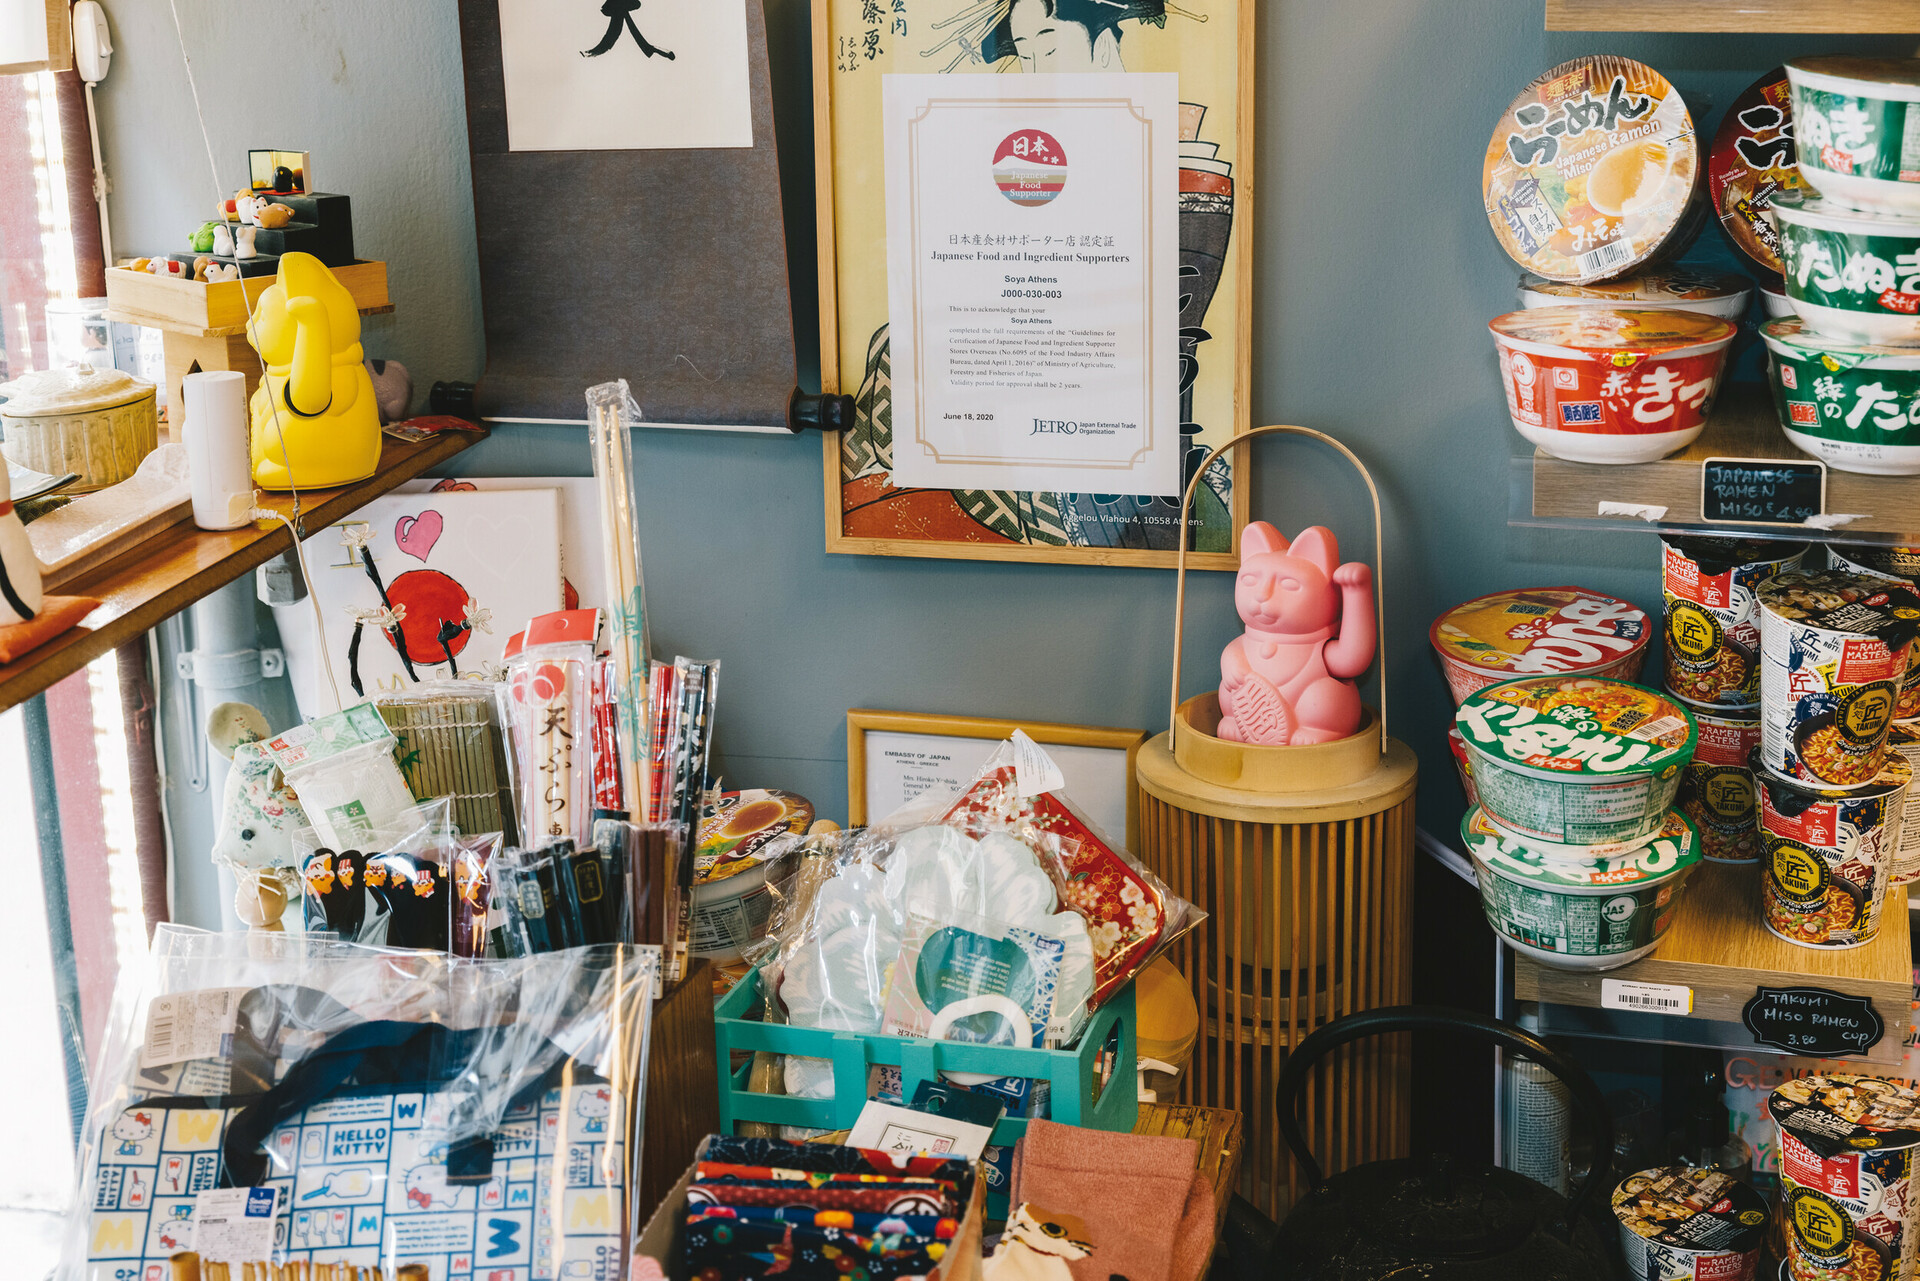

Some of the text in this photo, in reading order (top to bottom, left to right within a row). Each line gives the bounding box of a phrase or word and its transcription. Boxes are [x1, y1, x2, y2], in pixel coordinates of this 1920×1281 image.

[1507, 75, 1651, 168] らーめん
[1012, 135, 1050, 157] 日本
[1556, 119, 1662, 169] Japanese Ramen
[1010, 171, 1049, 180] Japanese
[1719, 170, 1734, 180] Ready
[1019, 180, 1041, 189] Food
[1721, 180, 1728, 188] 3
[1009, 188, 1052, 198] Supporter
[1515, 186, 1534, 204] Ramen
[1748, 181, 1778, 206] Authentic
[948, 234, 1115, 248] 日本産食材サポーター店 認定証
[1567, 217, 1626, 252] みそ味
[930, 251, 1129, 264] Japanese Food and Ingredient Supporters
[1004, 275, 1057, 284] Soya Athens
[1001, 289, 1062, 298] J000-030-003
[1067, 350, 1092, 358] Industry
[1600, 370, 1632, 413] 赤い
[1812, 376, 1847, 419] 緑の
[1029, 418, 1077, 435] JETRO
[1078, 428, 1116, 436] Organization
[1096, 422, 1120, 430] External
[1710, 465, 1795, 485] JAPANESE
[1713, 484, 1776, 499] RAMEN
[1720, 501, 1762, 517] MISO
[1063, 514, 1204, 527] Aggelou Vlahou 4, 10558 Atens
[1672, 555, 1699, 573] RAMEN
[1846, 649, 1892, 660] MASTERS
[1706, 726, 1741, 738] RAMEN
[1807, 806, 1829, 815] NISSIN
[1779, 875, 1812, 892] -TAKUMI-
[1603, 905, 1625, 917] JAS
[1768, 993, 1829, 1006] TAKUMI
[1763, 1007, 1859, 1028] MISO RAMEN
[1787, 1033, 1817, 1045] 3.80
[334, 1127, 386, 1143] HELLO
[332, 1141, 385, 1156] KITTY
[1783, 1143, 1823, 1168] MASTERS
[193, 1156, 206, 1192] HELLO
[203, 1157, 216, 1190] KITTY
[95, 1169, 109, 1207] HELLO
[106, 1170, 121, 1207] KITTY
[1680, 1212, 1714, 1231] RAMEN
[1681, 1217, 1724, 1239] MASTERS
[1802, 1226, 1835, 1246] -TAKUMI-
[1711, 1253, 1744, 1267] RAMEN
[1699, 1262, 1742, 1275] MASTERS
